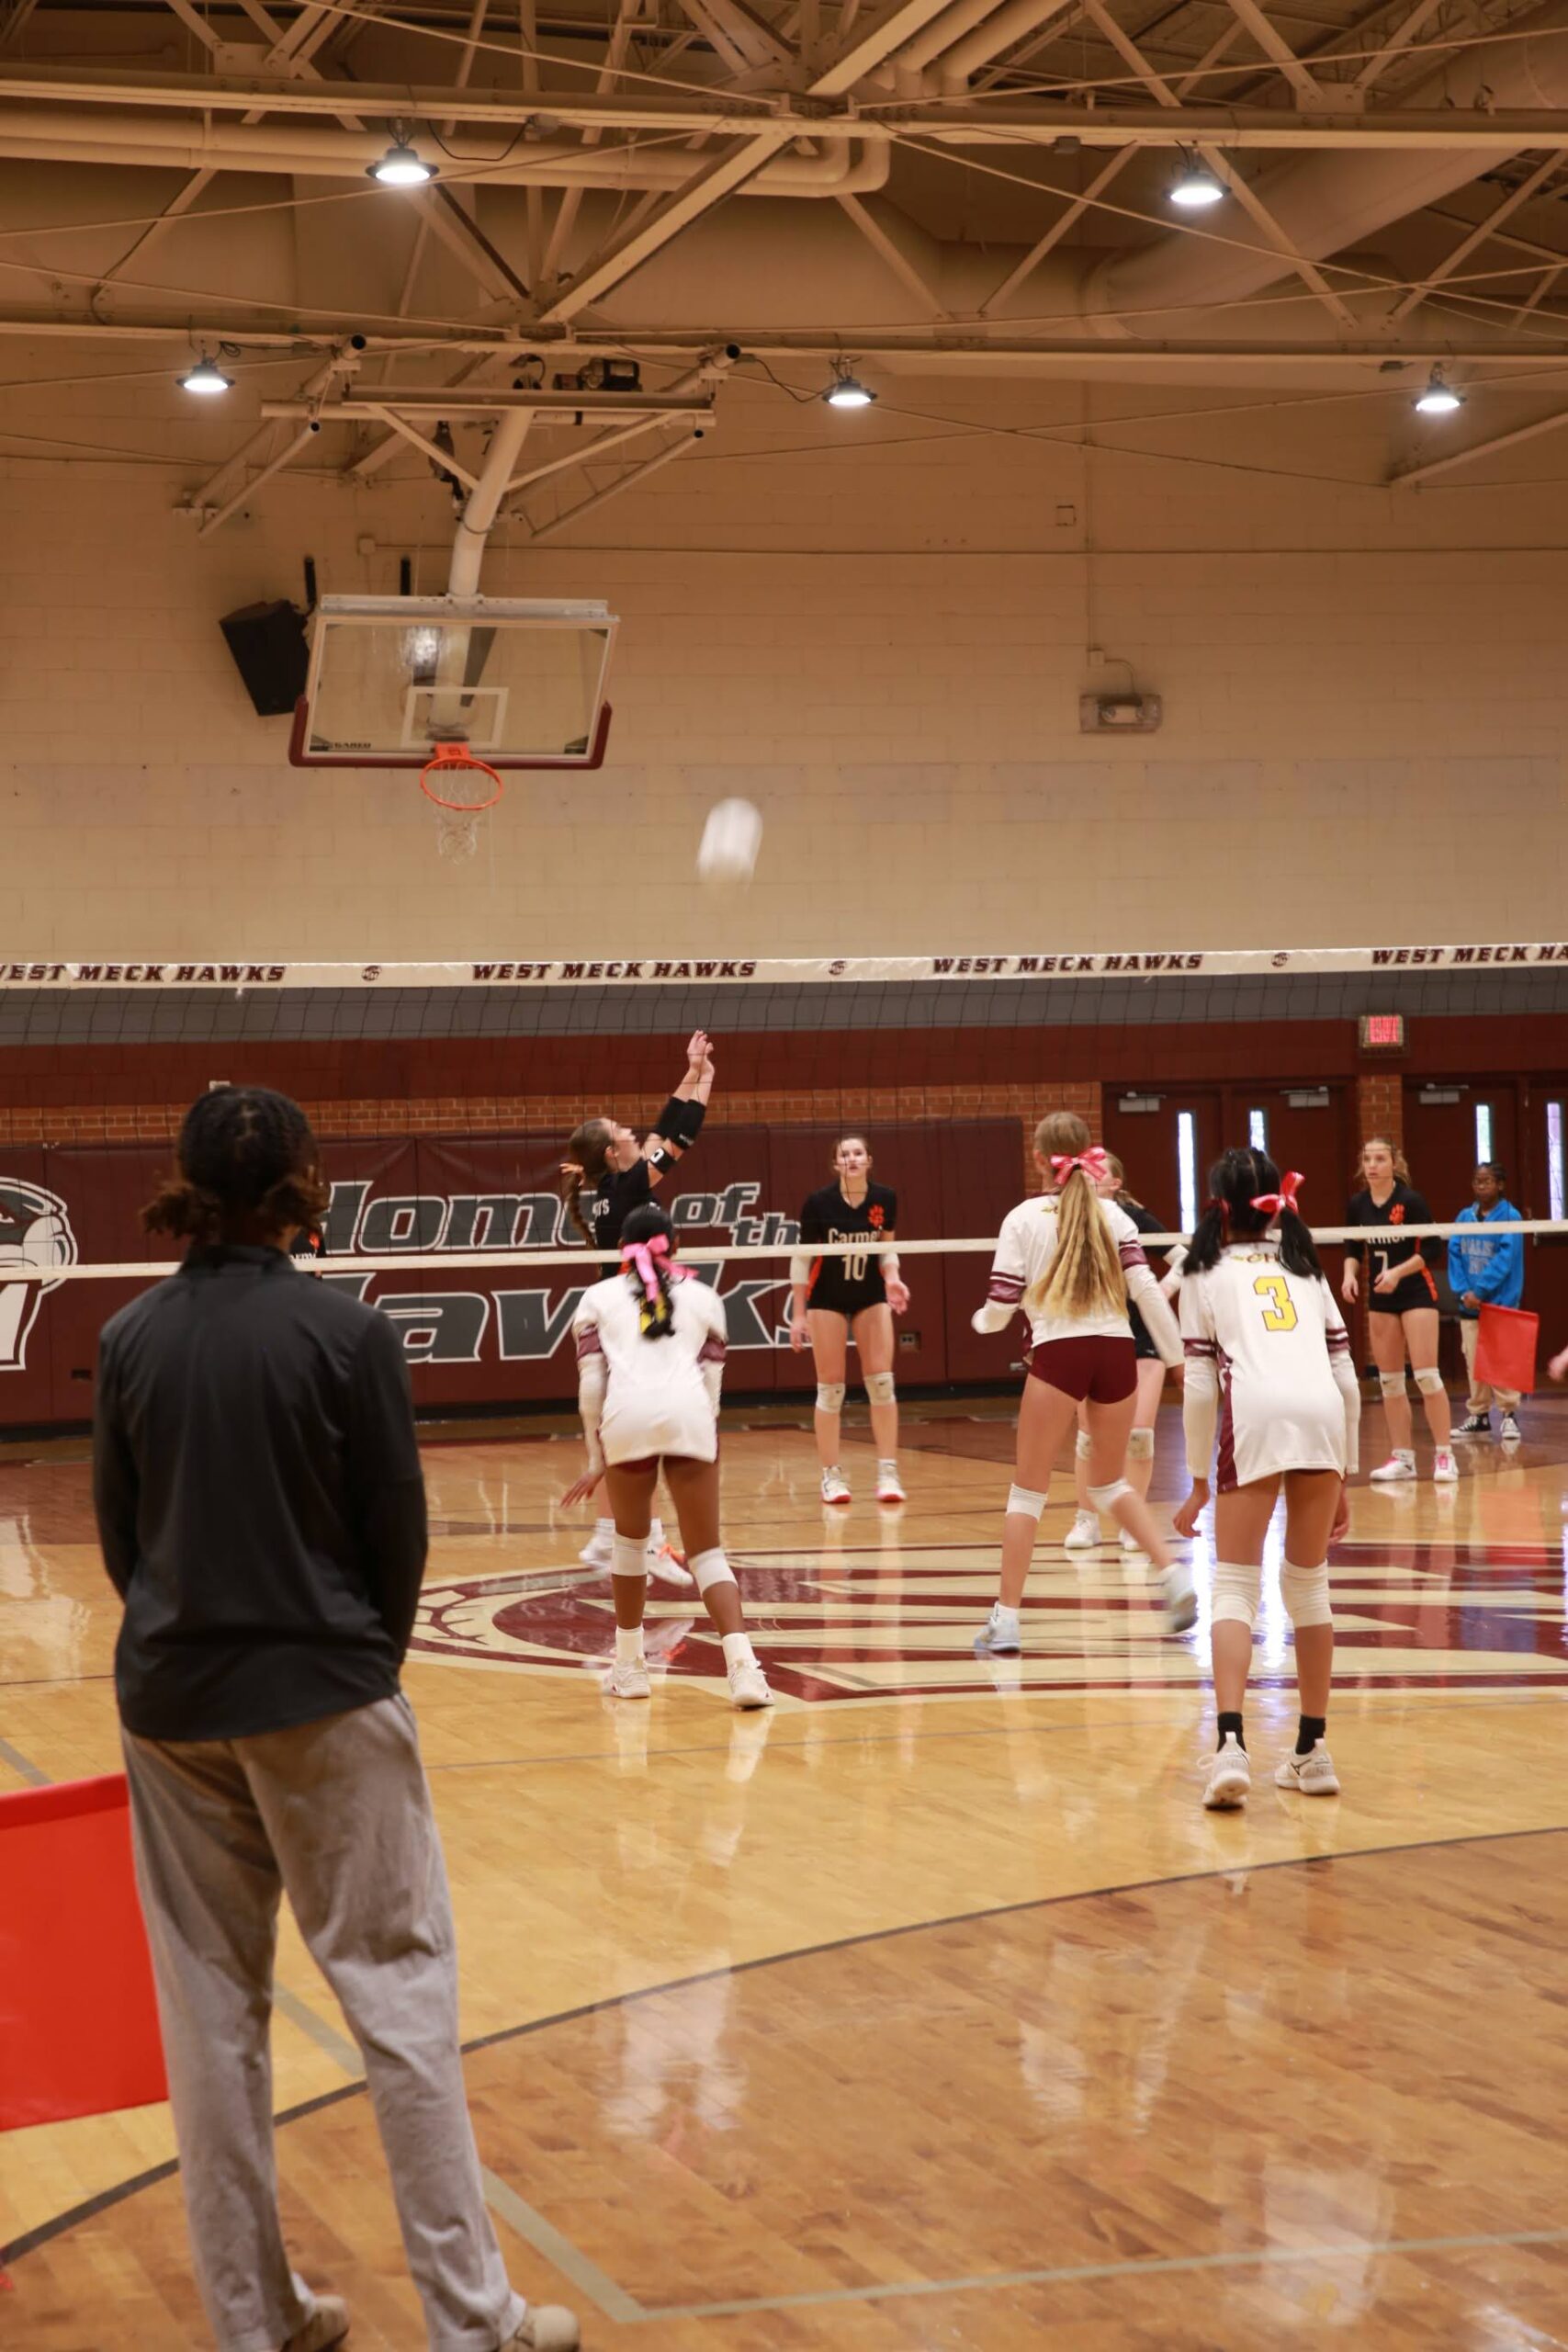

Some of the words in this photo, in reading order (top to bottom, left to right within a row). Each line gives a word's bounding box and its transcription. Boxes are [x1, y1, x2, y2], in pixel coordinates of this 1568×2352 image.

[931, 957, 1009, 974] WEST
[1014, 956, 1096, 973] MECK
[1100, 954, 1203, 972] HAWKS
[1371, 947, 1445, 966] WEST
[1450, 946, 1529, 964] MECK
[0, 965, 67, 982] EST
[73, 965, 164, 982] MECK
[172, 965, 287, 982] HAWKS
[471, 963, 552, 980] WEST
[557, 962, 645, 979] MECK
[649, 960, 757, 978] HAWKS
[671, 1182, 761, 1228] of
[729, 1213, 801, 1247] th
[828, 1227, 883, 1244] Carme
[841, 1253, 869, 1282] 10
[1253, 1276, 1299, 1332] 3
